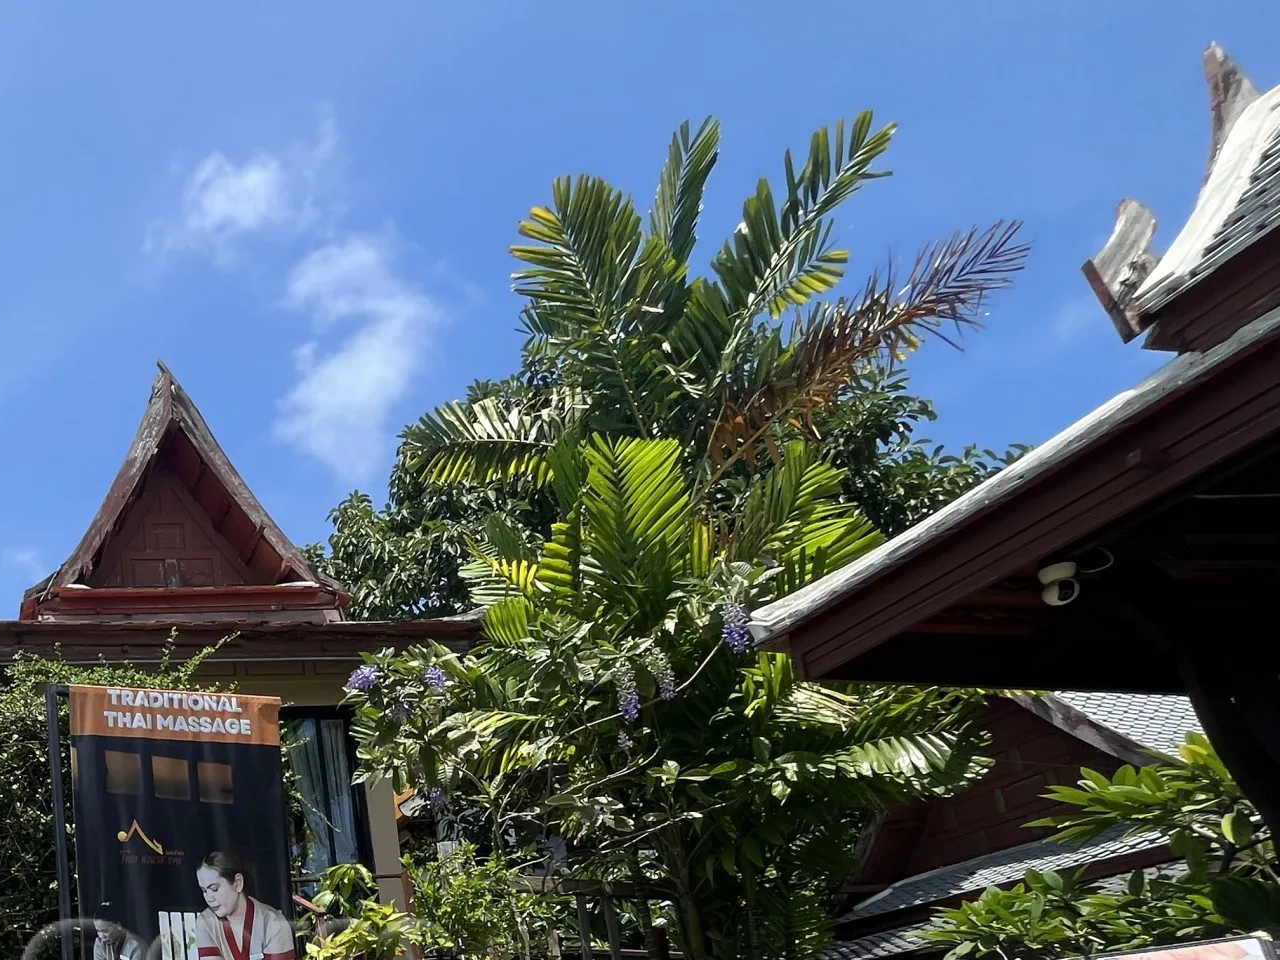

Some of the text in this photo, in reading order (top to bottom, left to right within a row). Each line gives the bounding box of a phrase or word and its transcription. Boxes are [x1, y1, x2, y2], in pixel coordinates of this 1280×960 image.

[106, 689, 243, 712] TRADITIONAL
[103, 710, 252, 735] THAI MASSAGE
